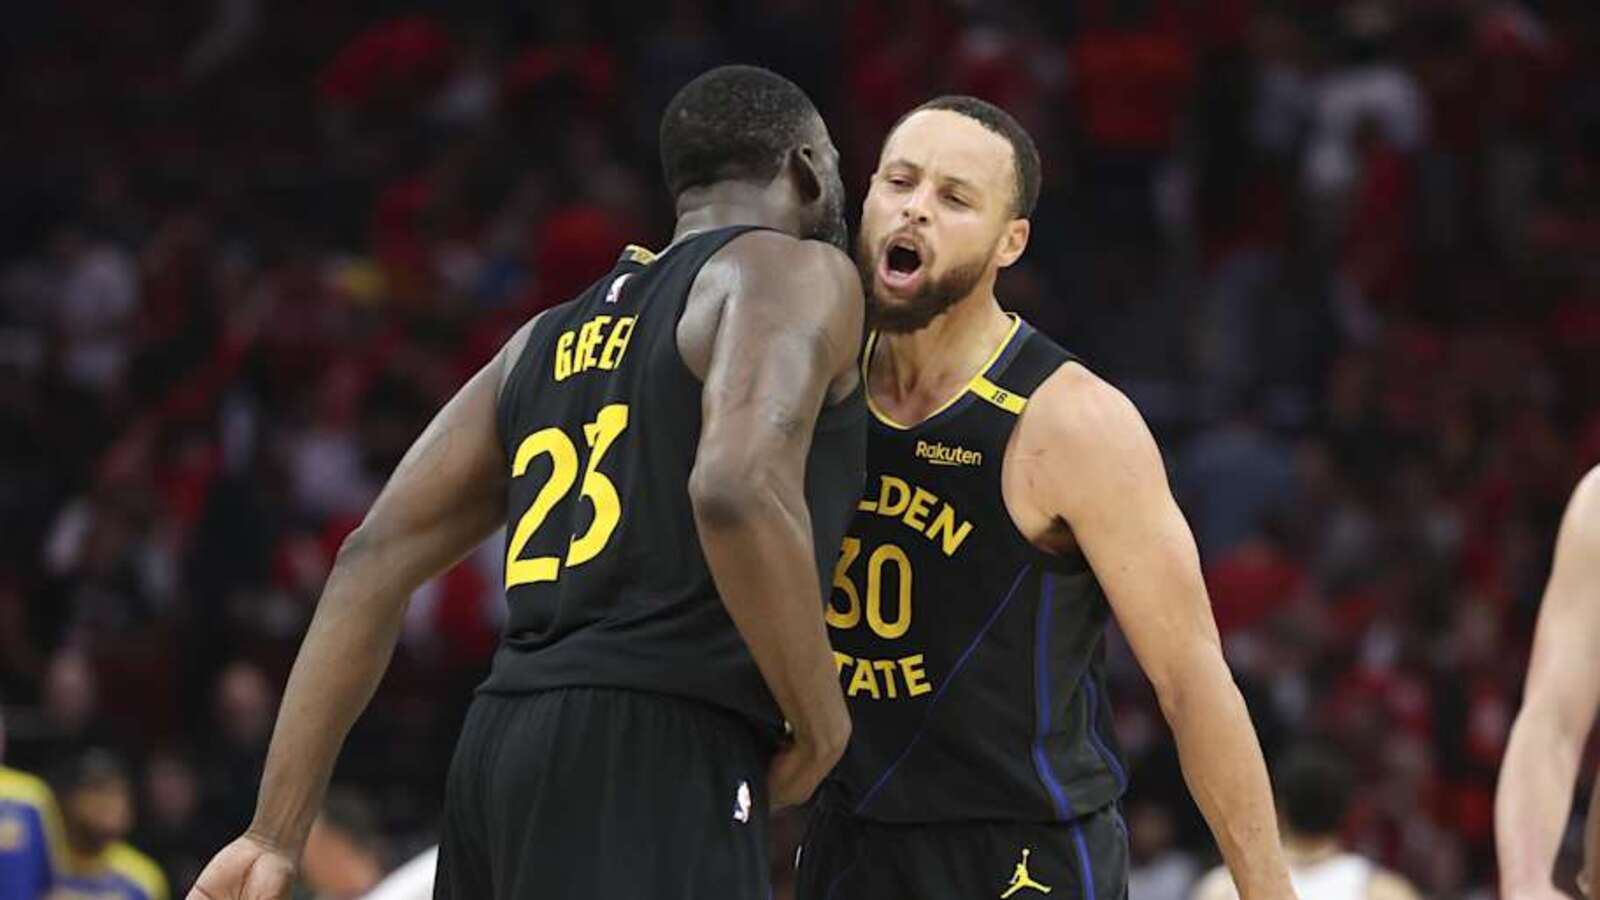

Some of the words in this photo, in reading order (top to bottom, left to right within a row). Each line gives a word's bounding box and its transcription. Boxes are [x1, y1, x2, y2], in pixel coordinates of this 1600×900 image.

[554, 314, 639, 381] GREE
[915, 440, 982, 466] Rakuten
[505, 404, 629, 590] 23
[825, 537, 912, 639] 30
